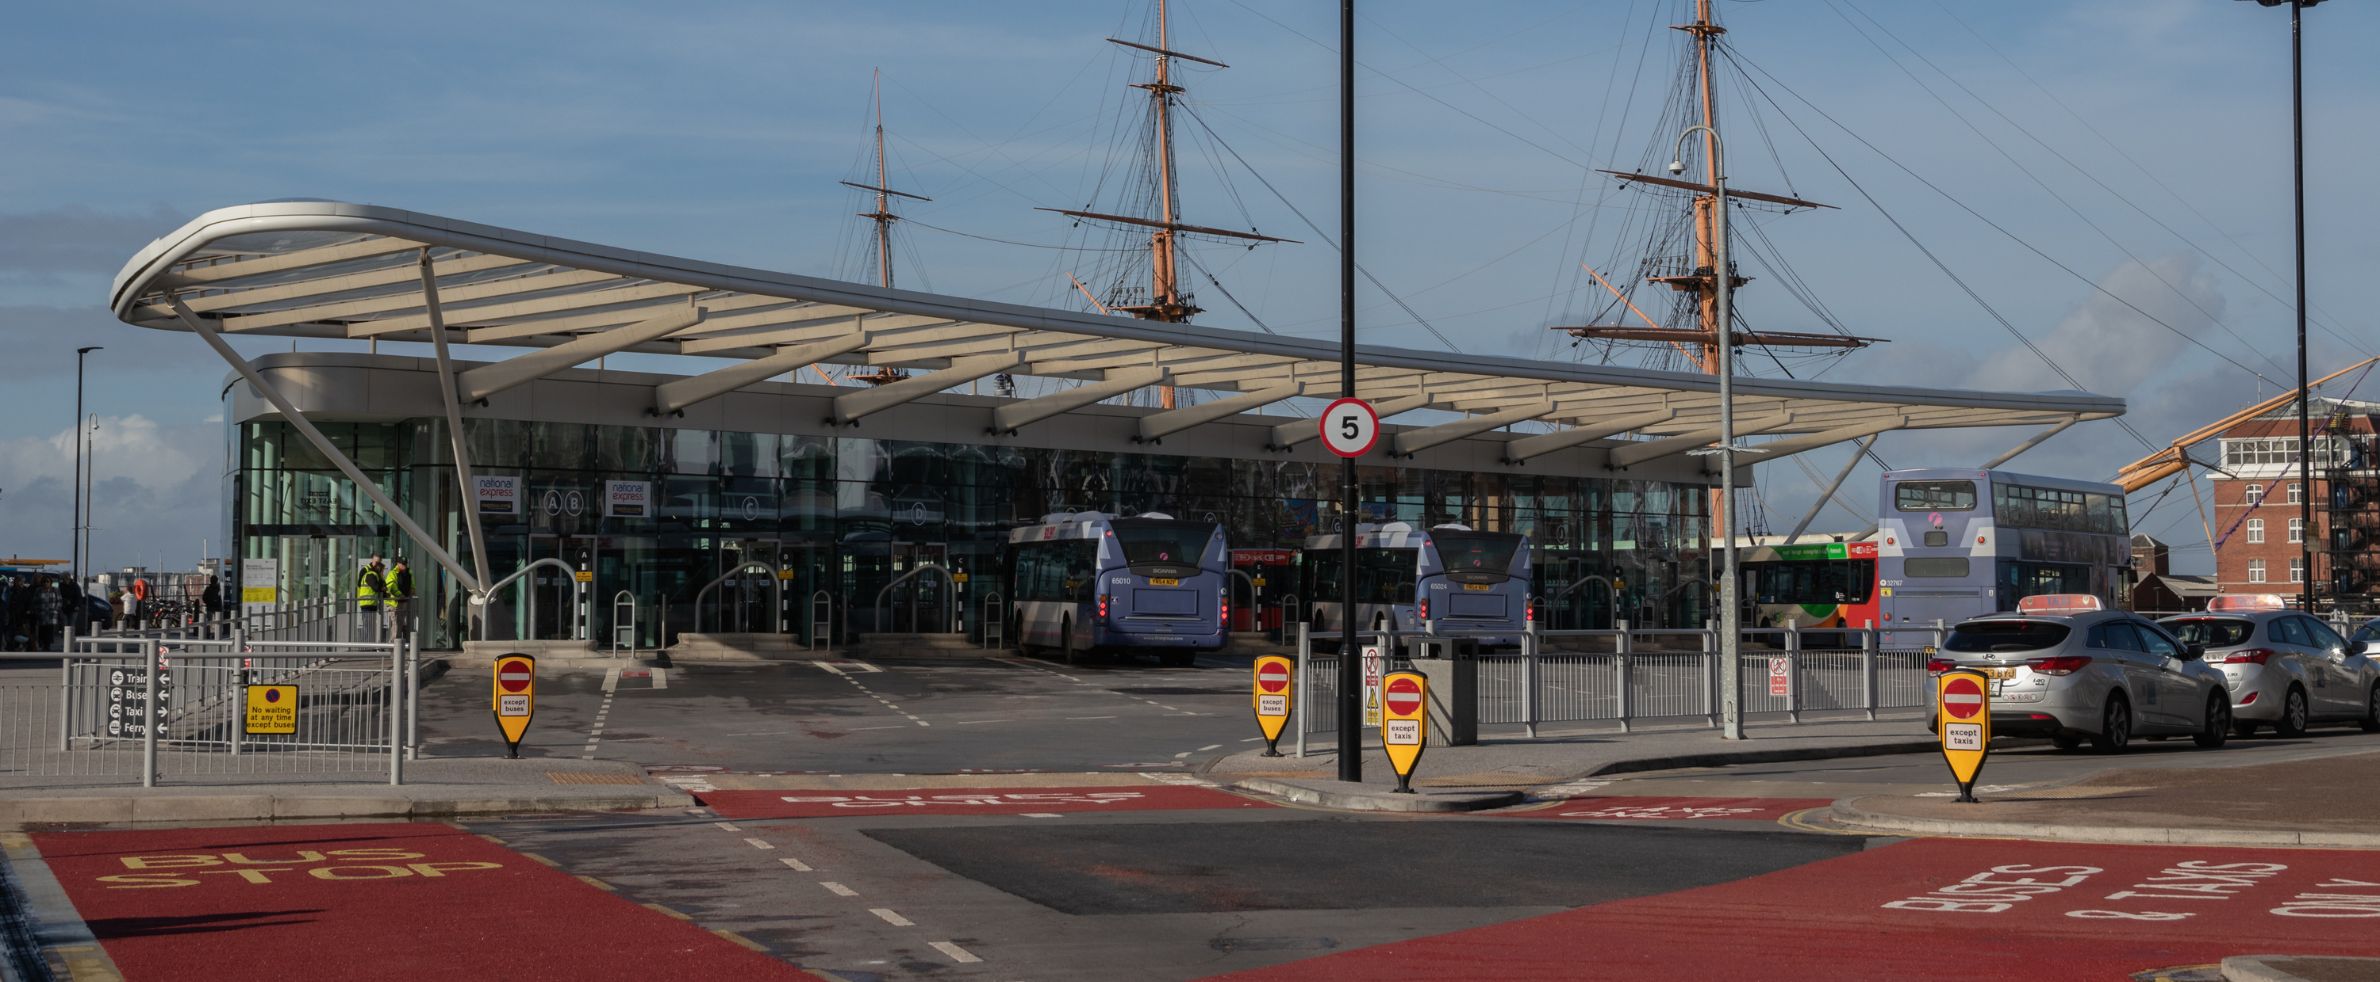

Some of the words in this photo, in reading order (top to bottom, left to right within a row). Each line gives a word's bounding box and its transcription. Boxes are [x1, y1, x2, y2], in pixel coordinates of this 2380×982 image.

[1342, 416, 1359, 440] 5
[480, 478, 513, 488] national
[480, 488, 513, 499] express
[549, 497, 558, 509] A
[570, 497, 578, 509] B
[1111, 577, 1131, 585] 65010
[126, 690, 148, 700] Buse
[125, 706, 143, 717] Taxi
[265, 706, 291, 715] waiting
[124, 722, 147, 736] Ferry
[1950, 729, 1977, 737] except
[120, 847, 425, 869] BUS
[96, 861, 503, 889] STOP
[2104, 860, 2288, 900] TAXIS
[1881, 863, 2104, 913] BUSES
[2064, 909, 2197, 921] &
